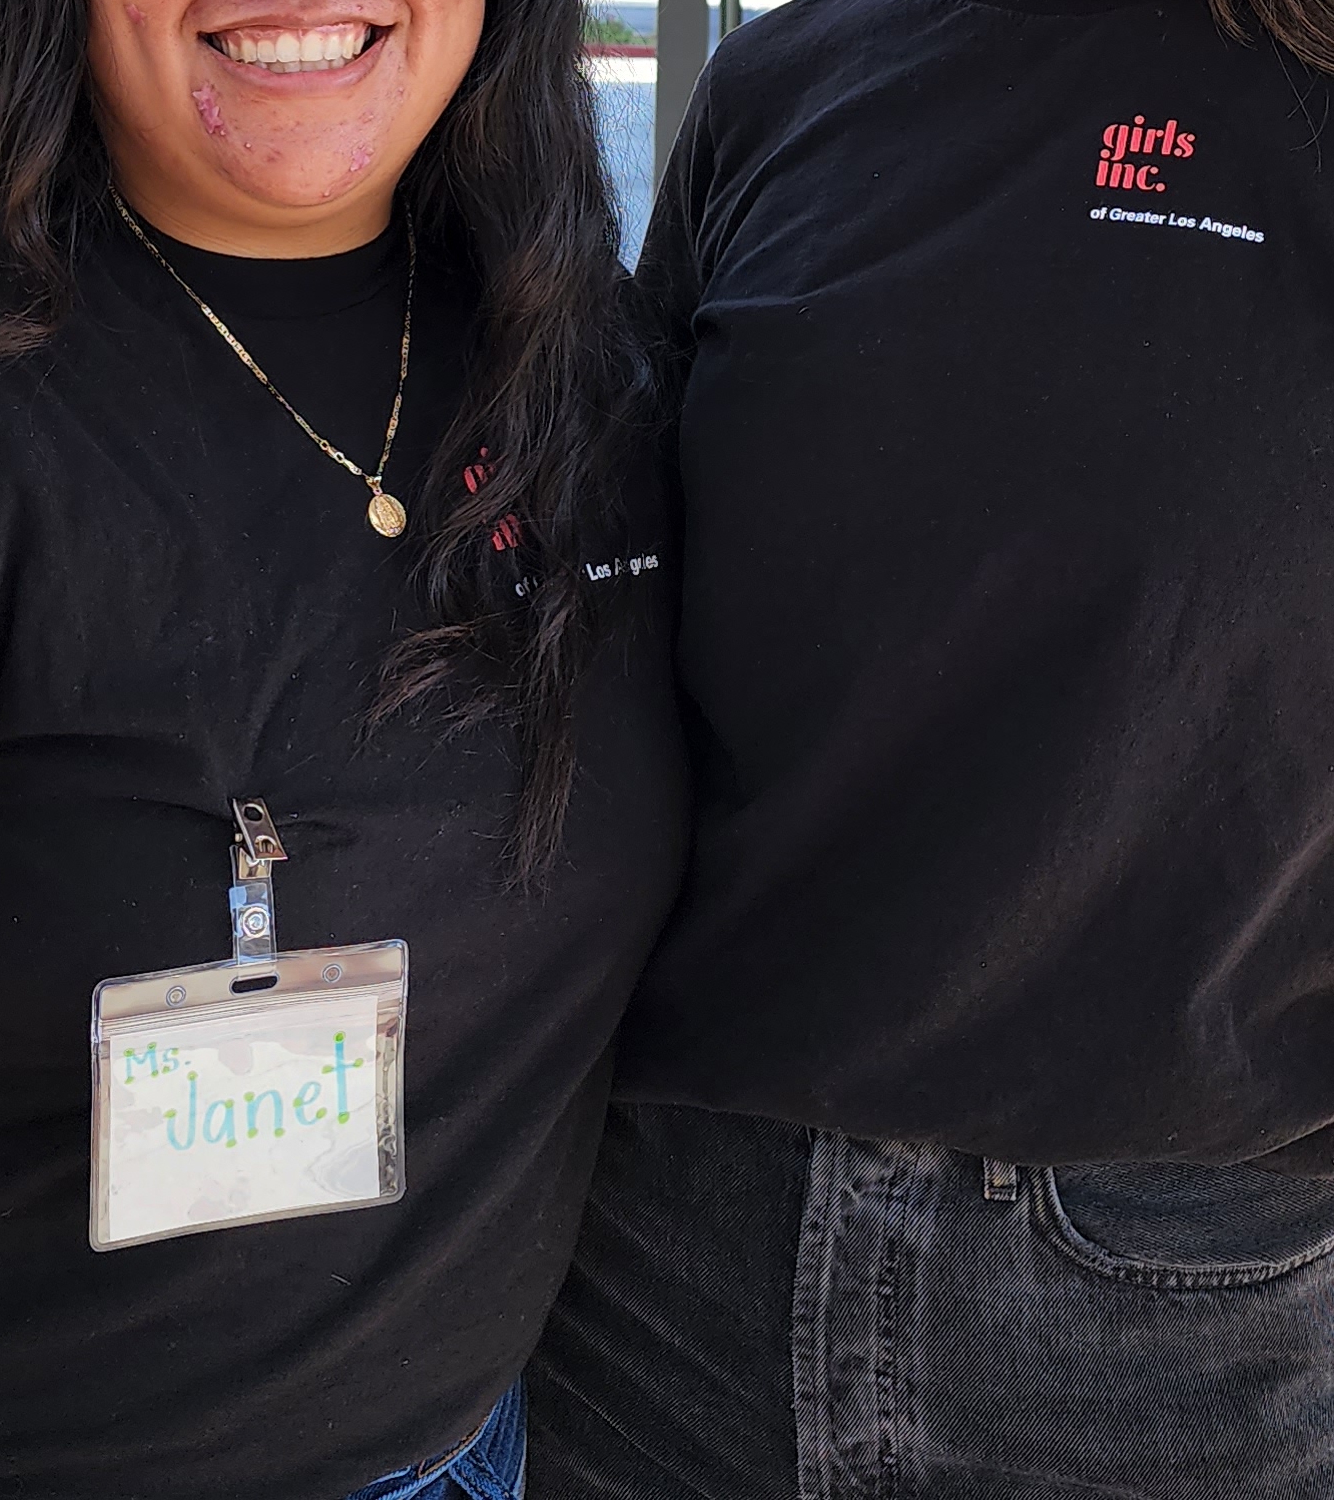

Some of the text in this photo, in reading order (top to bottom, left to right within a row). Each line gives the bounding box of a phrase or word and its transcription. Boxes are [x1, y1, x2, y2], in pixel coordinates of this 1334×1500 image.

[1100, 115, 1195, 161] girls
[1095, 154, 1166, 192] inc.
[1090, 207, 1265, 243] of Greater Los Angeles
[585, 562, 612, 581] Los
[123, 1042, 191, 1085] Ms.
[165, 1032, 364, 1152] Janet
